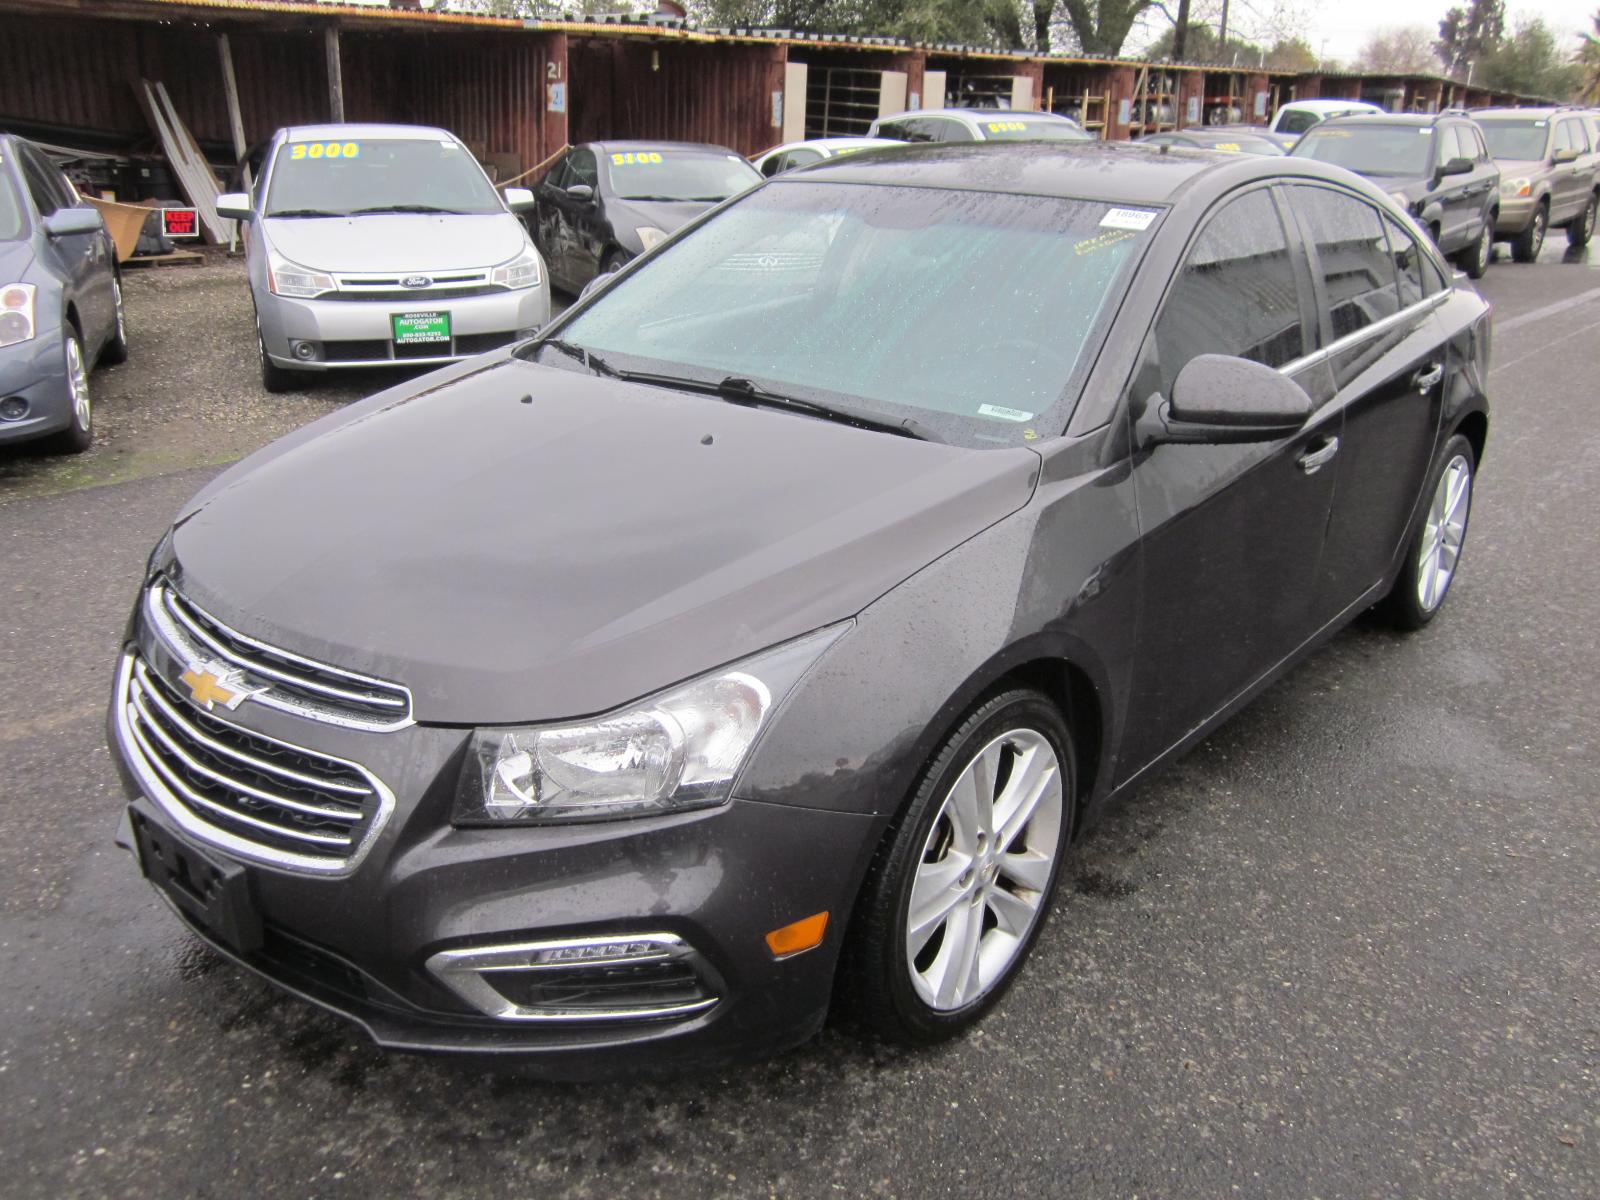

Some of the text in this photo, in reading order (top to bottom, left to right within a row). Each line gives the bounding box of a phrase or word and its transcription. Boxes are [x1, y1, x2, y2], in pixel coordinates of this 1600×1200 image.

[291, 143, 358, 160] 3000
[166, 211, 195, 221] KEEP
[169, 222, 192, 233] OUT
